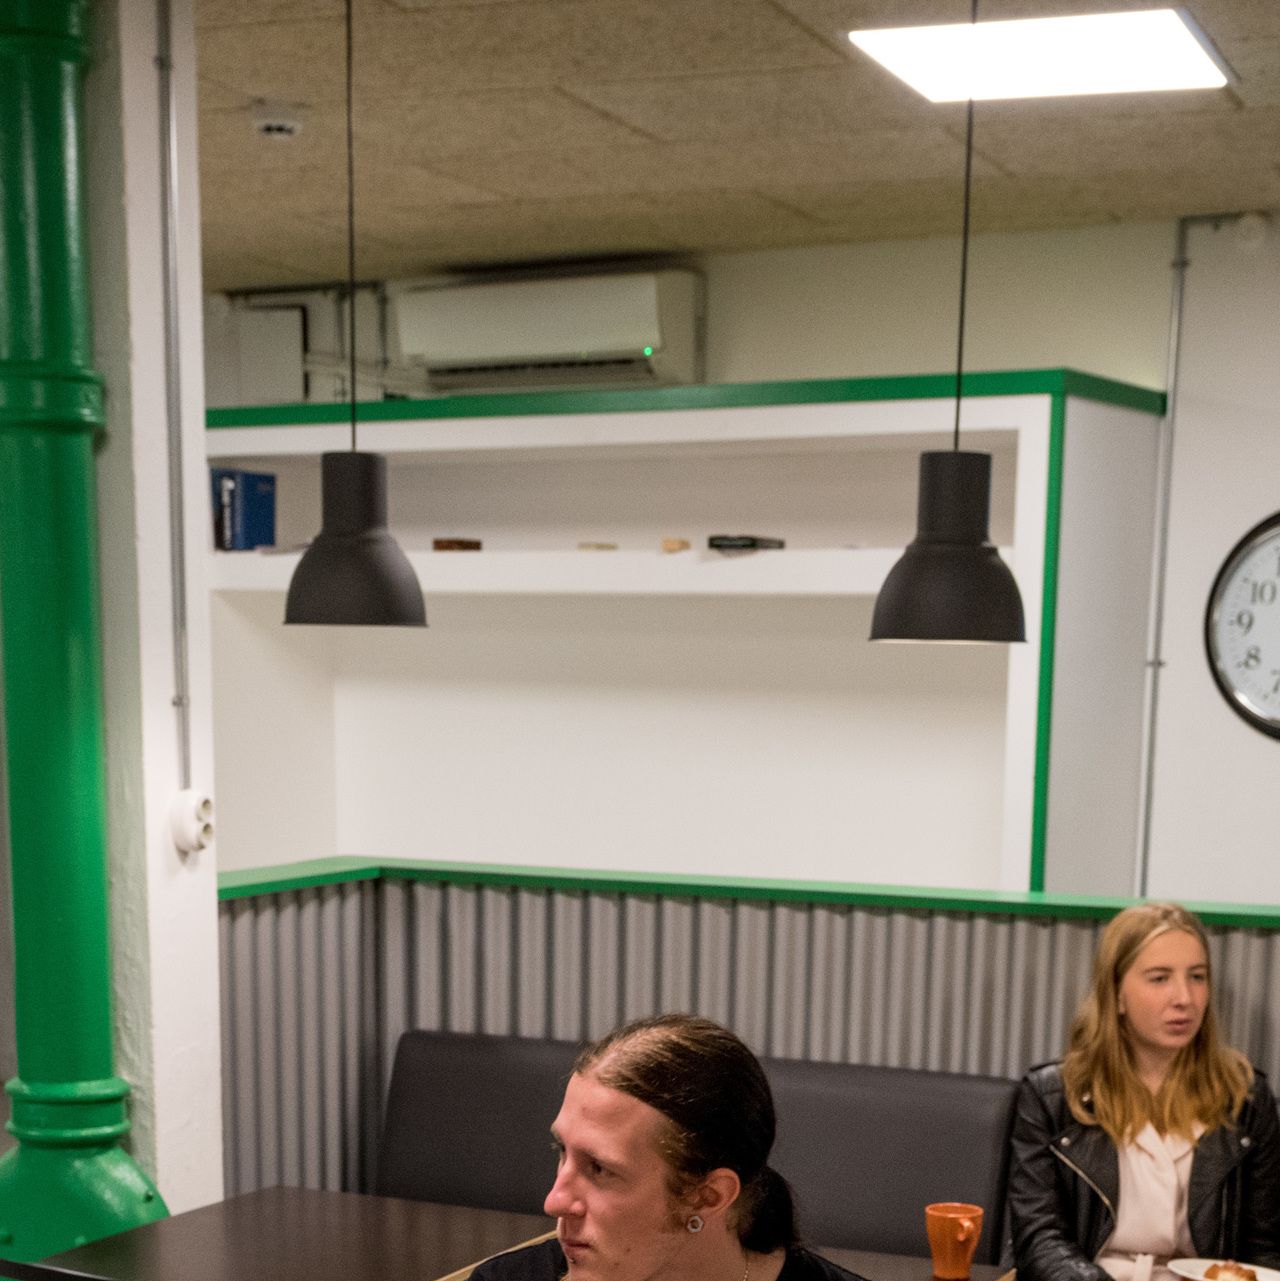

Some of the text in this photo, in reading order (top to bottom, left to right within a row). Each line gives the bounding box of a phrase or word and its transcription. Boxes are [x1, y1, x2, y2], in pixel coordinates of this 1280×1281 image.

[1251, 580, 1276, 606] 10
[1236, 610, 1254, 636] 9
[1243, 645, 1260, 670] 8
